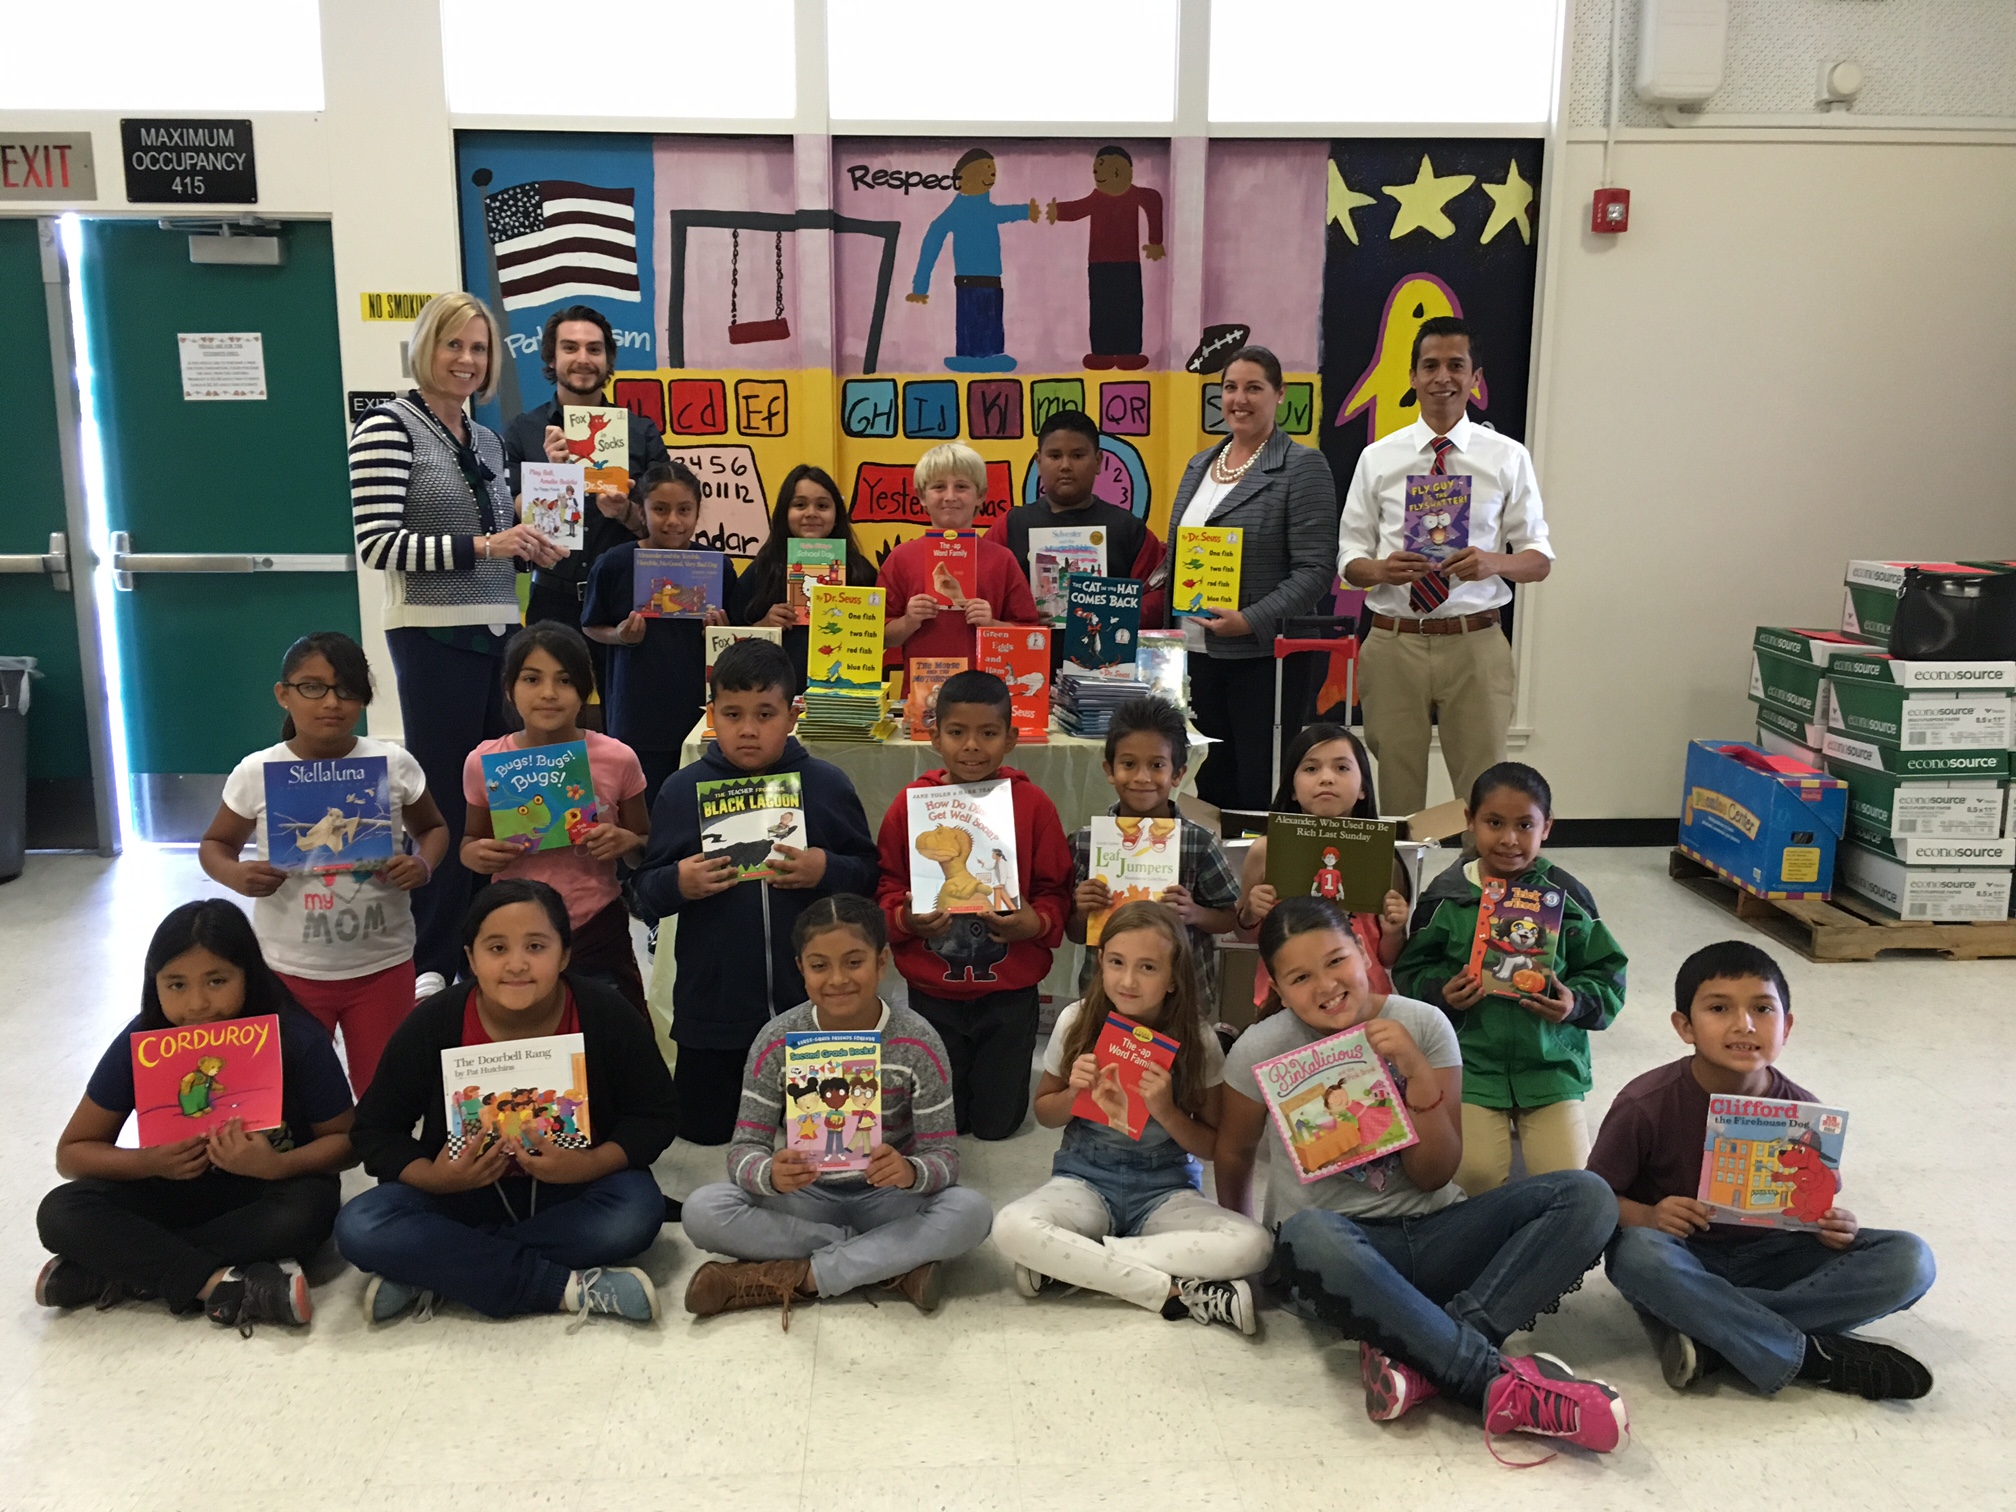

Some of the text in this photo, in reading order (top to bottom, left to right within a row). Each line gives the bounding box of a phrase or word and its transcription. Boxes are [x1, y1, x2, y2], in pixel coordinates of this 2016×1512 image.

[140, 128, 235, 147] MAXIMUM
[1, 145, 72, 188] EXIT
[132, 151, 246, 171] OCCUPANCY
[171, 176, 205, 195] 415
[847, 164, 962, 195] Respect
[368, 294, 432, 319] NO SMOKIN
[743, 395, 780, 431] Ef
[847, 397, 892, 434] GH
[1106, 395, 1146, 425] QR
[569, 414, 587, 427] Fox
[598, 437, 624, 452] Socks
[690, 455, 702, 470] 4
[710, 456, 726, 474] 5
[731, 456, 748, 476] 6
[1113, 468, 1123, 482] 2
[735, 483, 754, 503] 12
[1120, 487, 1129, 504] 3
[1411, 485, 1430, 496] FLY
[1433, 480, 1454, 491] GUY
[1409, 495, 1468, 512] FLYSWATTER!
[1188, 532, 1221, 543] Dr. Seuss
[821, 550, 835, 559] Day
[949, 550, 967, 558] Family
[1852, 567, 1902, 584] econosource
[1082, 581, 1101, 592] CAT
[1117, 584, 1139, 594] HAT
[824, 592, 861, 604] Dr. Seuss
[1071, 593, 1138, 608] COMES BACK
[982, 629, 1010, 639] Green
[712, 636, 731, 651] Fox
[992, 642, 1014, 653] Eggs
[1759, 633, 1801, 653] econosource
[985, 667, 1005, 675] Ham
[1833, 660, 1881, 675] econosource
[1914, 670, 2003, 681] econosource
[1767, 686, 1812, 710] econosource
[1011, 705, 1036, 718] Seuss
[1907, 707, 1975, 716] econosource
[1761, 709, 1798, 732] econosource
[1848, 715, 1897, 735] econosource
[1827, 741, 1873, 760] econosource
[495, 750, 576, 778] Bugs! Bugs!
[1907, 757, 1997, 769] econosource
[288, 761, 365, 785] Stellaluna
[511, 770, 567, 792] Bugs!
[728, 787, 753, 796] TEACHER
[703, 793, 799, 817] BLACK LAGOON
[925, 799, 967, 811] How Do
[1899, 796, 1966, 805] econosource
[928, 810, 999, 841] Get Well Soon?
[1275, 815, 1317, 827] Alexander,
[1320, 818, 1340, 828] Who
[1342, 820, 1363, 830] Used
[1377, 823, 1389, 831] Be
[1728, 803, 1755, 833] Center
[1297, 828, 1371, 842] Rich Last Sunday
[1096, 847, 1121, 867] Leaf
[1916, 847, 2003, 857] econosource
[1116, 858, 1173, 878] Jumpers
[1324, 873, 1334, 890] 1
[1910, 881, 1976, 889] econosource
[304, 892, 335, 910] my
[1549, 894, 1556, 903] 3
[302, 902, 387, 944] MOM
[138, 1023, 269, 1068] CORDUROY
[1122, 1037, 1137, 1051] The
[453, 1049, 552, 1069] The Doorbell Rang
[790, 1046, 876, 1061] Second Grade Rocks!
[1108, 1043, 1153, 1069] Word Fami
[454, 1064, 515, 1079] by Pat Hutchins
[1268, 1044, 1363, 1092] Pinkalicious
[1710, 1099, 1799, 1119] Clifford
[1733, 1117, 1787, 1127] Firehouse
[1789, 1120, 1810, 1129] Dog
